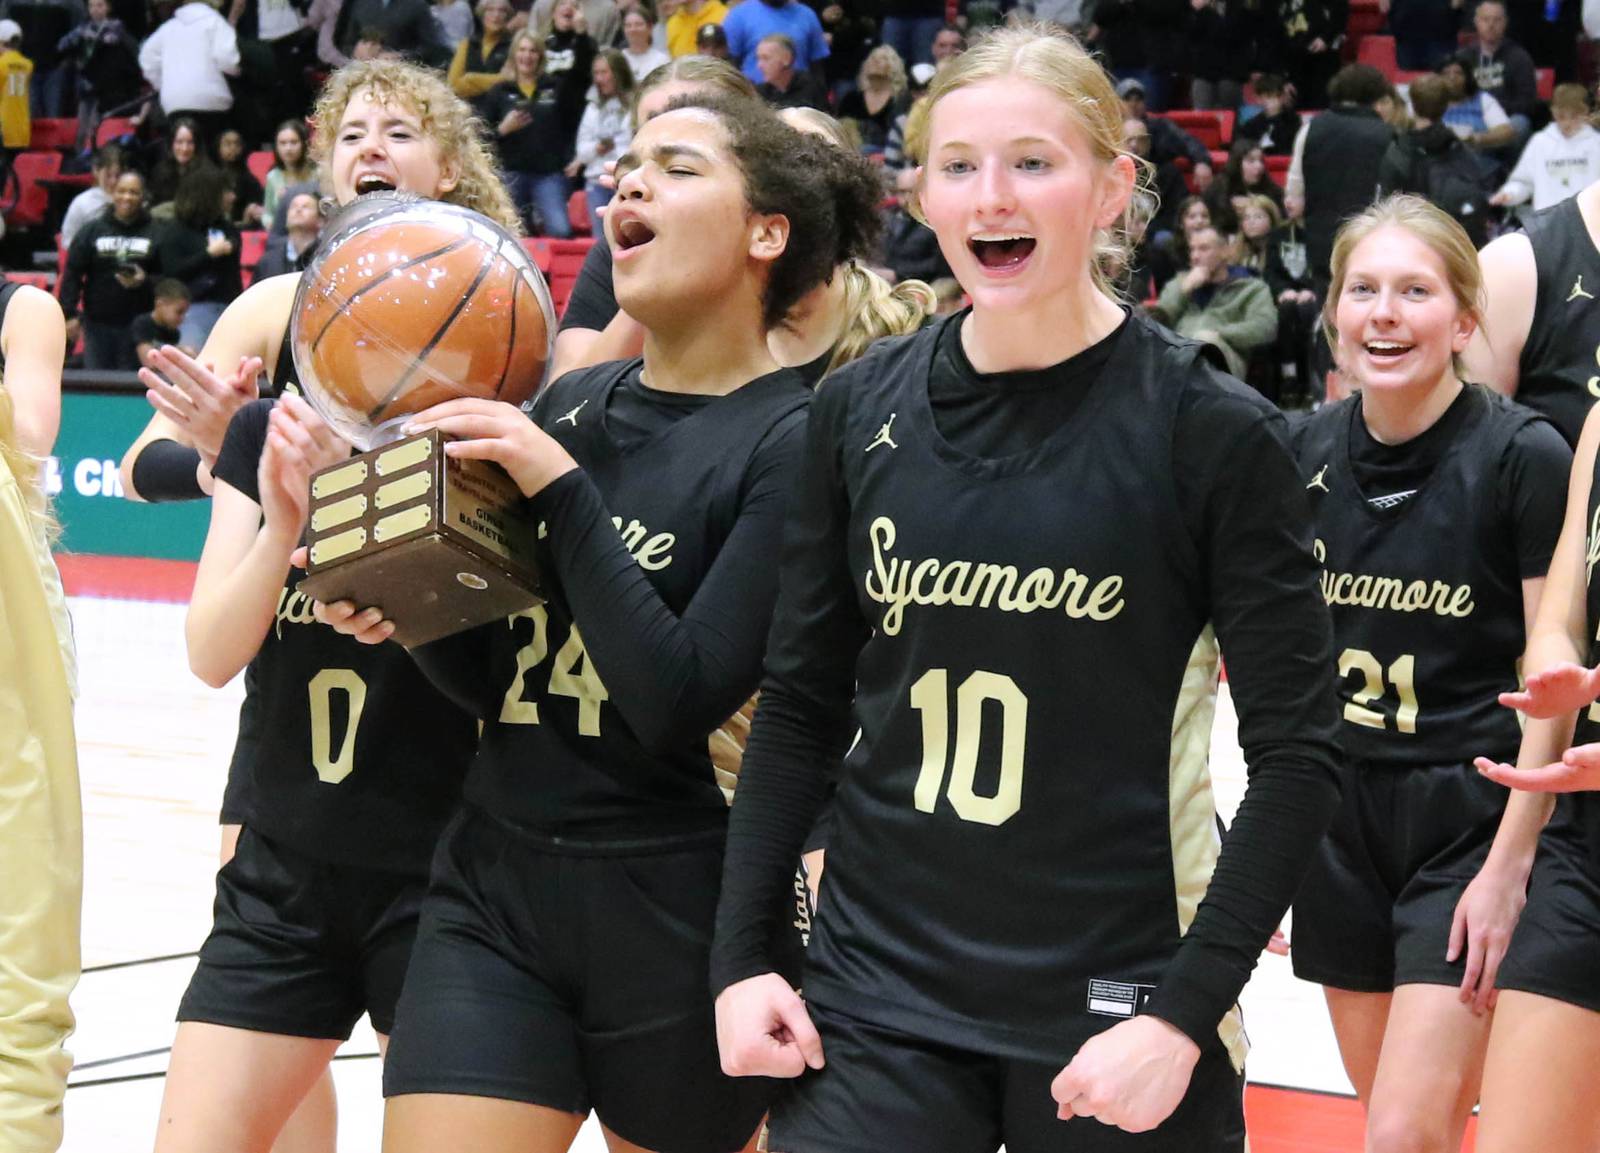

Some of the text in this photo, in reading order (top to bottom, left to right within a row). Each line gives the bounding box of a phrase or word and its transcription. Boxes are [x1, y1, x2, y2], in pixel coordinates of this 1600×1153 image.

[73, 457, 124, 497] Ch
[865, 516, 1125, 636] Sycamore
[308, 669, 367, 784] 0
[499, 604, 609, 736] 24
[1337, 648, 1419, 734] 21
[910, 668, 1028, 827] 10
